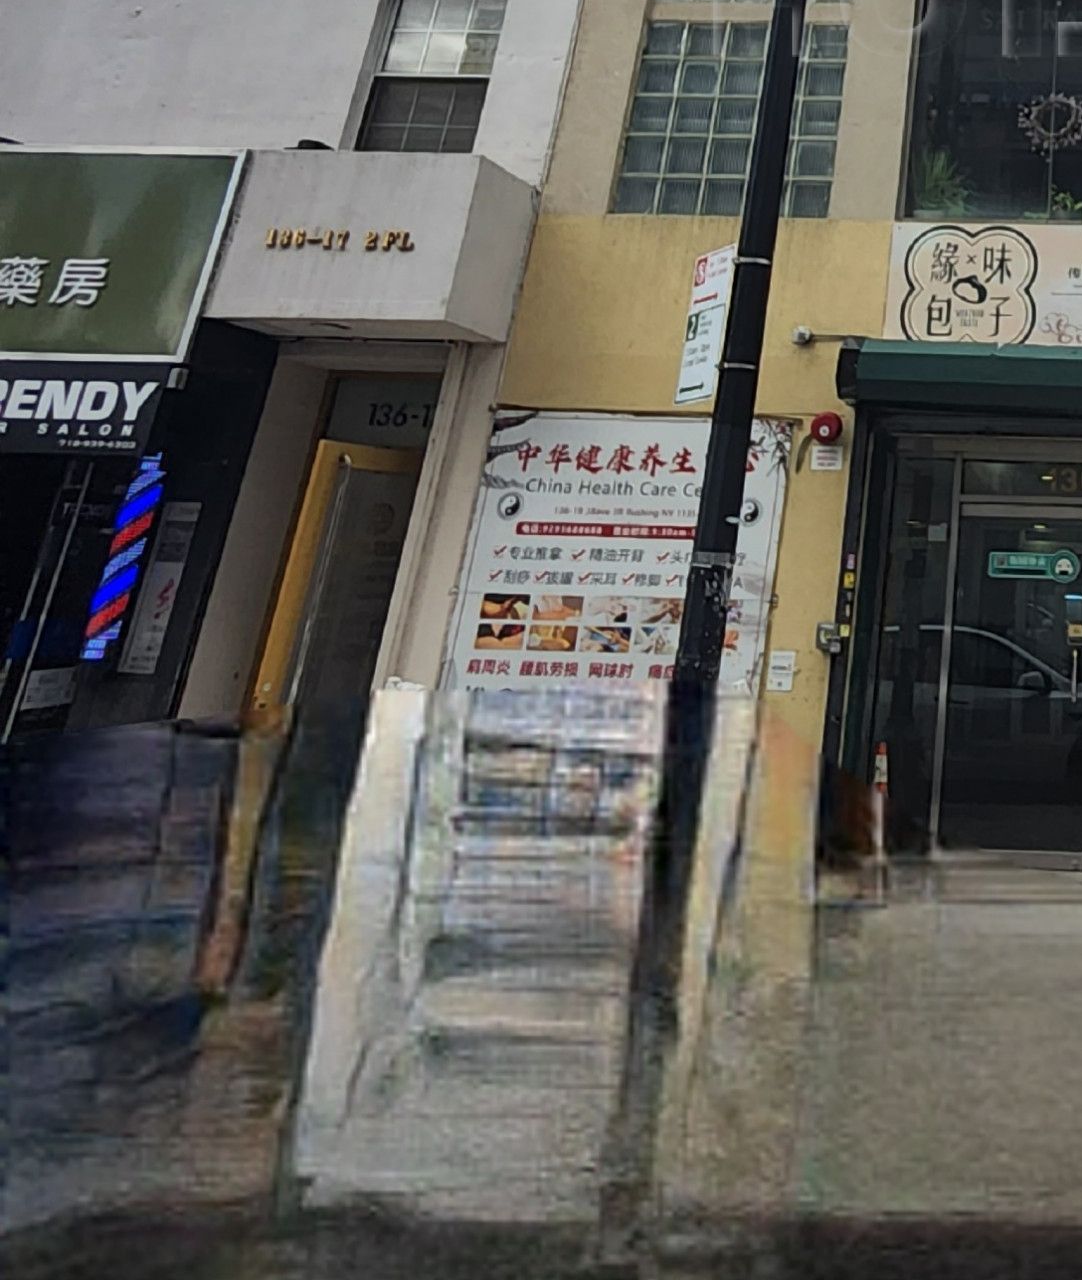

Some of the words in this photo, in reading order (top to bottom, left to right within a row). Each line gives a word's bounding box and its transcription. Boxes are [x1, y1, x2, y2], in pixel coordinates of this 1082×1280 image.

[265, 228, 349, 250] 136-17
[363, 230, 415, 252] 2FL
[0, 257, 110, 307] 藥房
[0, 380, 159, 421] ENDY
[369, 403, 435, 428] 136-1
[37, 423, 134, 437] SALON
[517, 443, 759, 476] 中华健康养生
[526, 479, 571, 494] China
[579, 480, 633, 497] Health
[640, 482, 676, 497] Care
